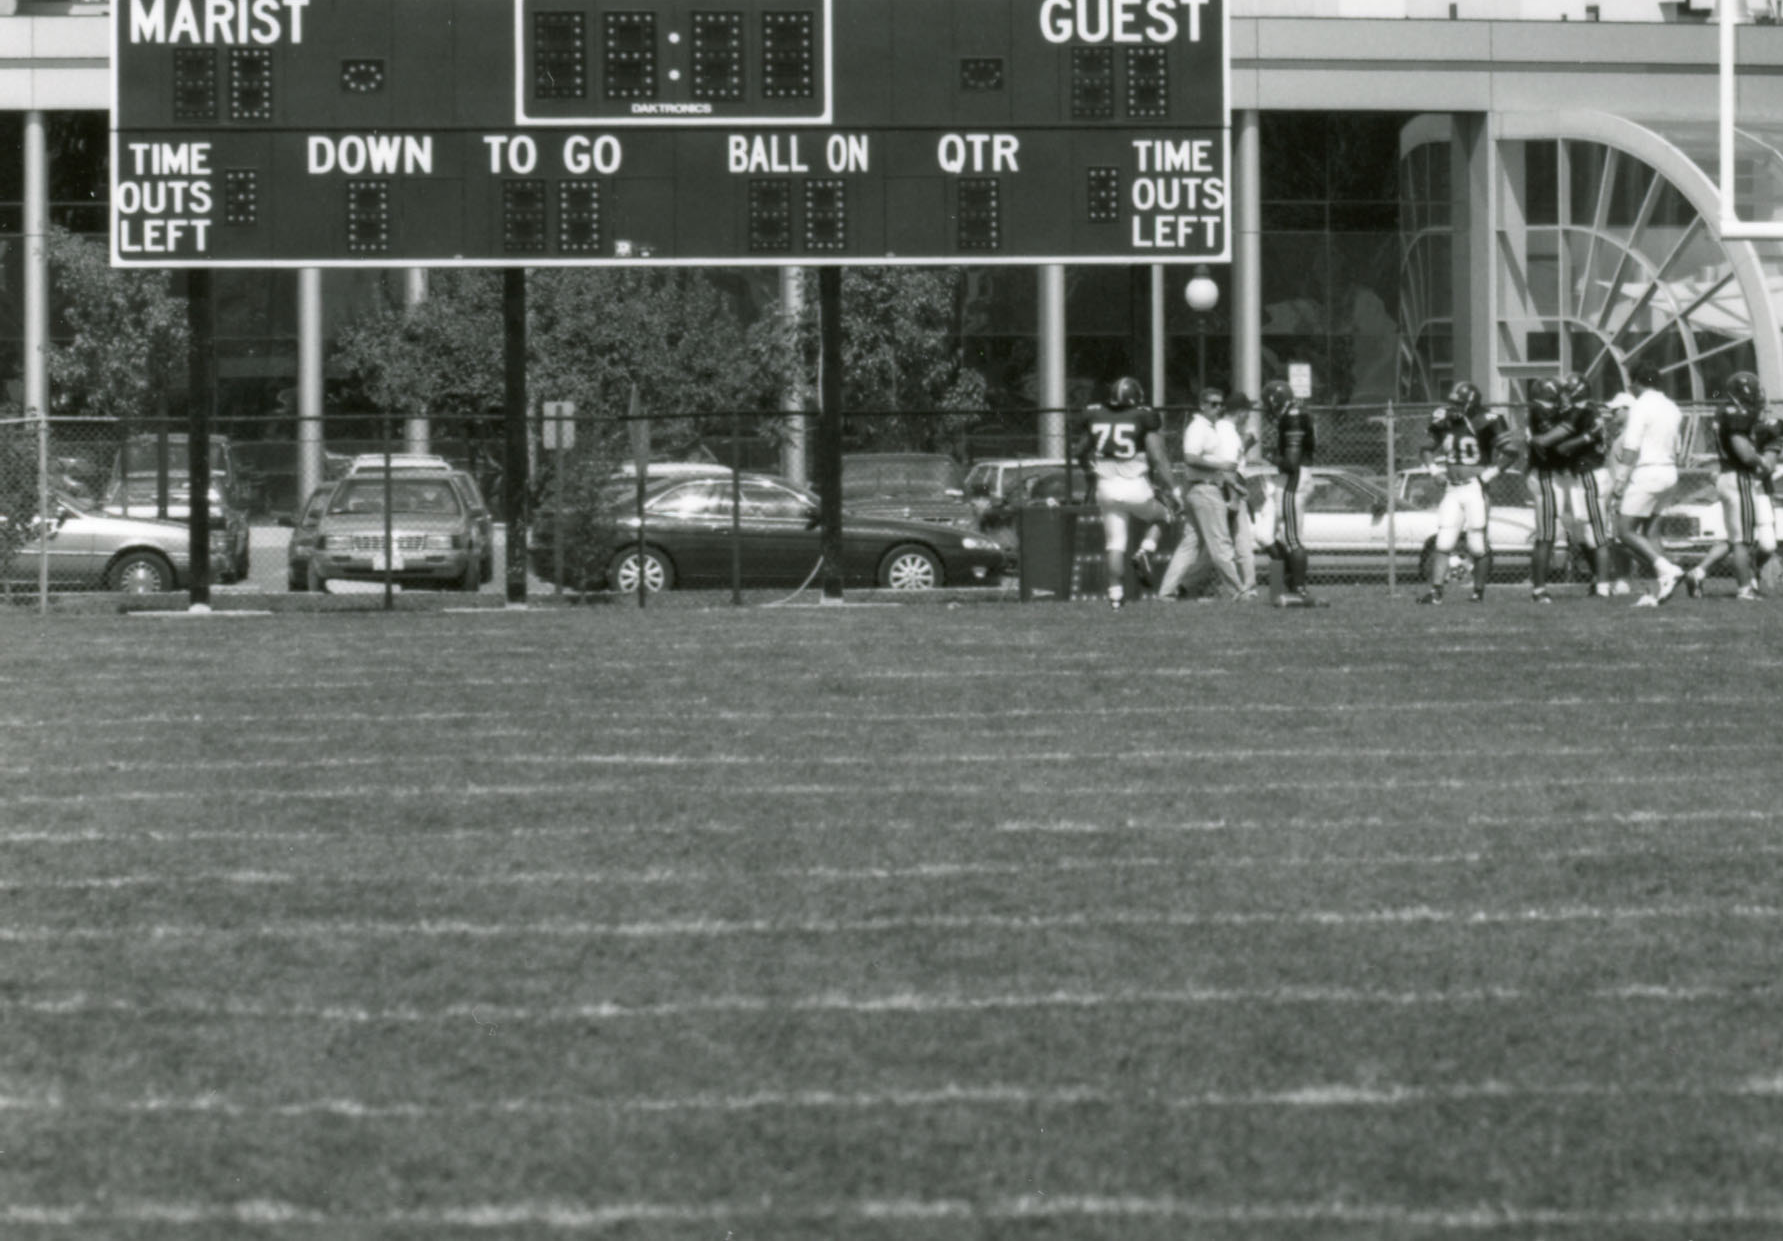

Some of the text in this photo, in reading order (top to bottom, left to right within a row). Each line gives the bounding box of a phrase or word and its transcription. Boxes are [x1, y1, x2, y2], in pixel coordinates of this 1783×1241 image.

[631, 103, 712, 114] DAKTRONICS
[129, 142, 212, 175] TIME
[307, 135, 433, 174] DOWN
[483, 135, 622, 174] TO GO
[728, 134, 869, 173] BALL ON
[937, 134, 1020, 174] QTR
[1132, 140, 1213, 172] TIME
[118, 181, 213, 214] OUTS
[1131, 178, 1224, 210] OUTS
[119, 219, 212, 252] LEFT
[1132, 215, 1221, 248] LEFT
[1091, 423, 1136, 458] 75
